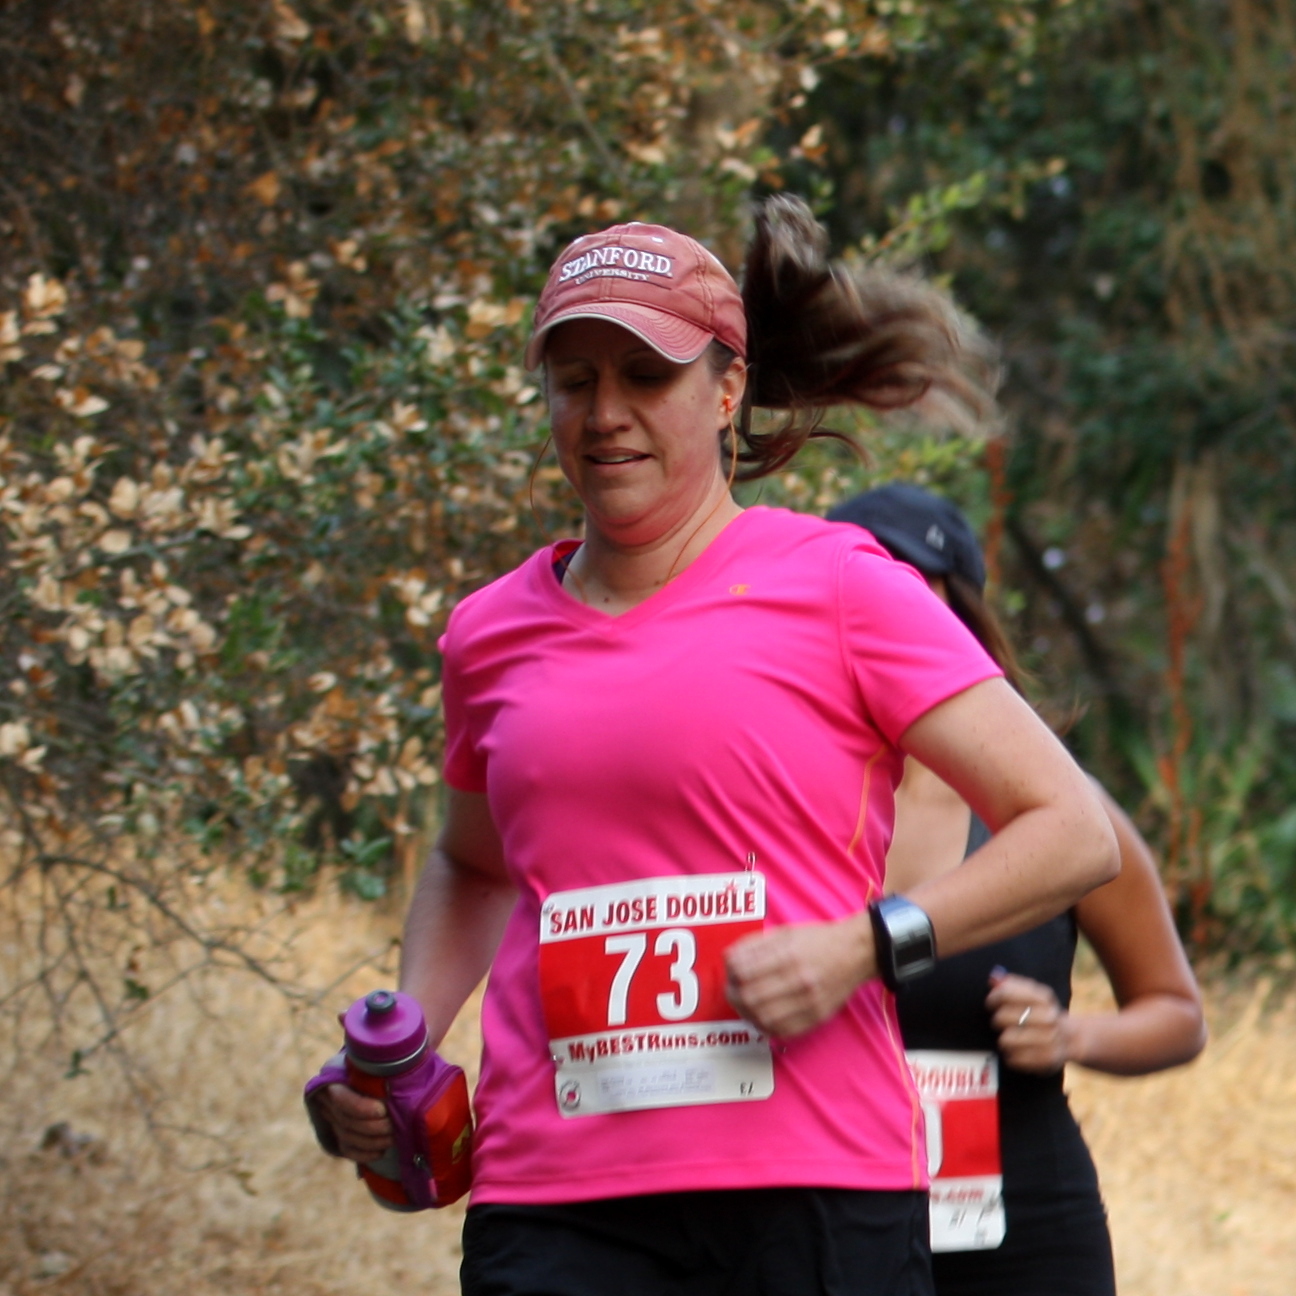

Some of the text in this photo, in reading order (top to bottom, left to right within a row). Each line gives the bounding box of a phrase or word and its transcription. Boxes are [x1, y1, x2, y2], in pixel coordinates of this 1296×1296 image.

[559, 246, 671, 282] STANFORD
[575, 268, 650, 285] UNIVERSITY
[550, 889, 757, 934] SAN JOSE DOUBLE
[603, 926, 700, 1027] 73
[567, 1029, 751, 1065] MyBESTRuns.com
